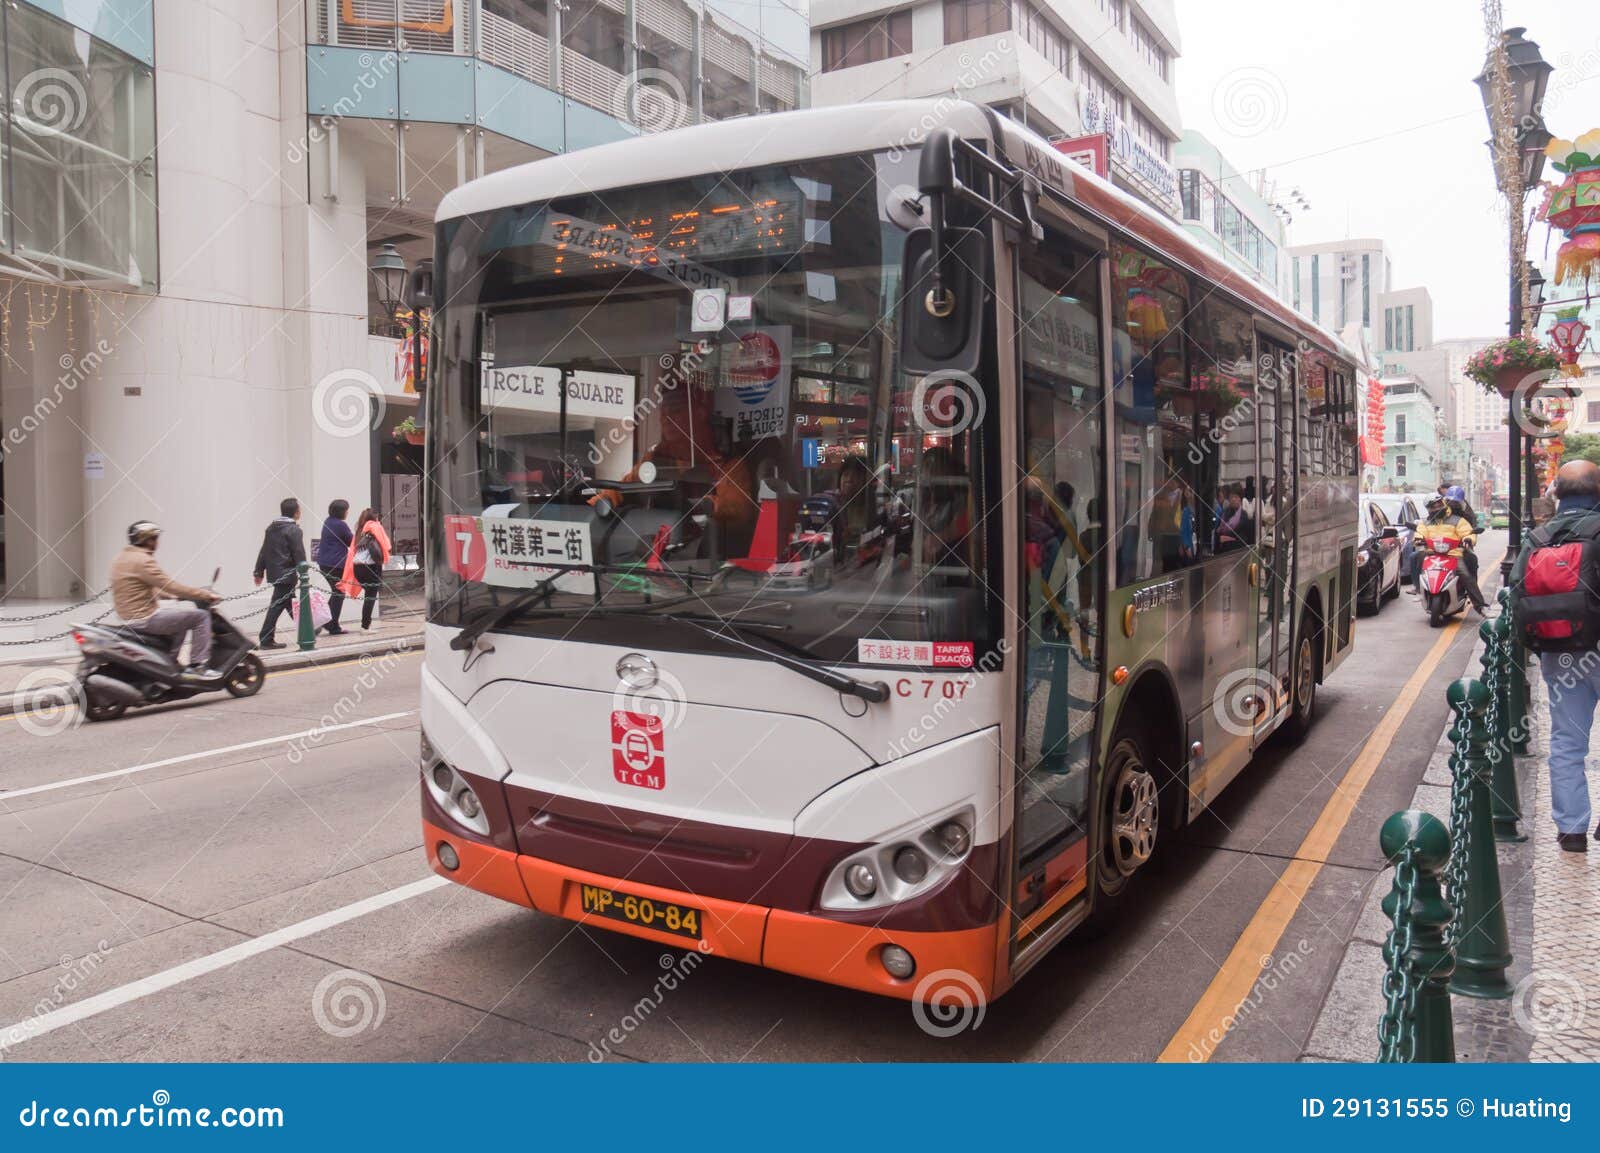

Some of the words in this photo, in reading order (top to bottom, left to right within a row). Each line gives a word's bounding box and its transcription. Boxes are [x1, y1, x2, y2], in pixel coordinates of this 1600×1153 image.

[483, 369, 544, 395] IRCLE
[456, 532, 473, 565] 7
[936, 645, 971, 654] TARIFA
[618, 769, 660, 788] TCM
[582, 886, 699, 935] MP-60-84
